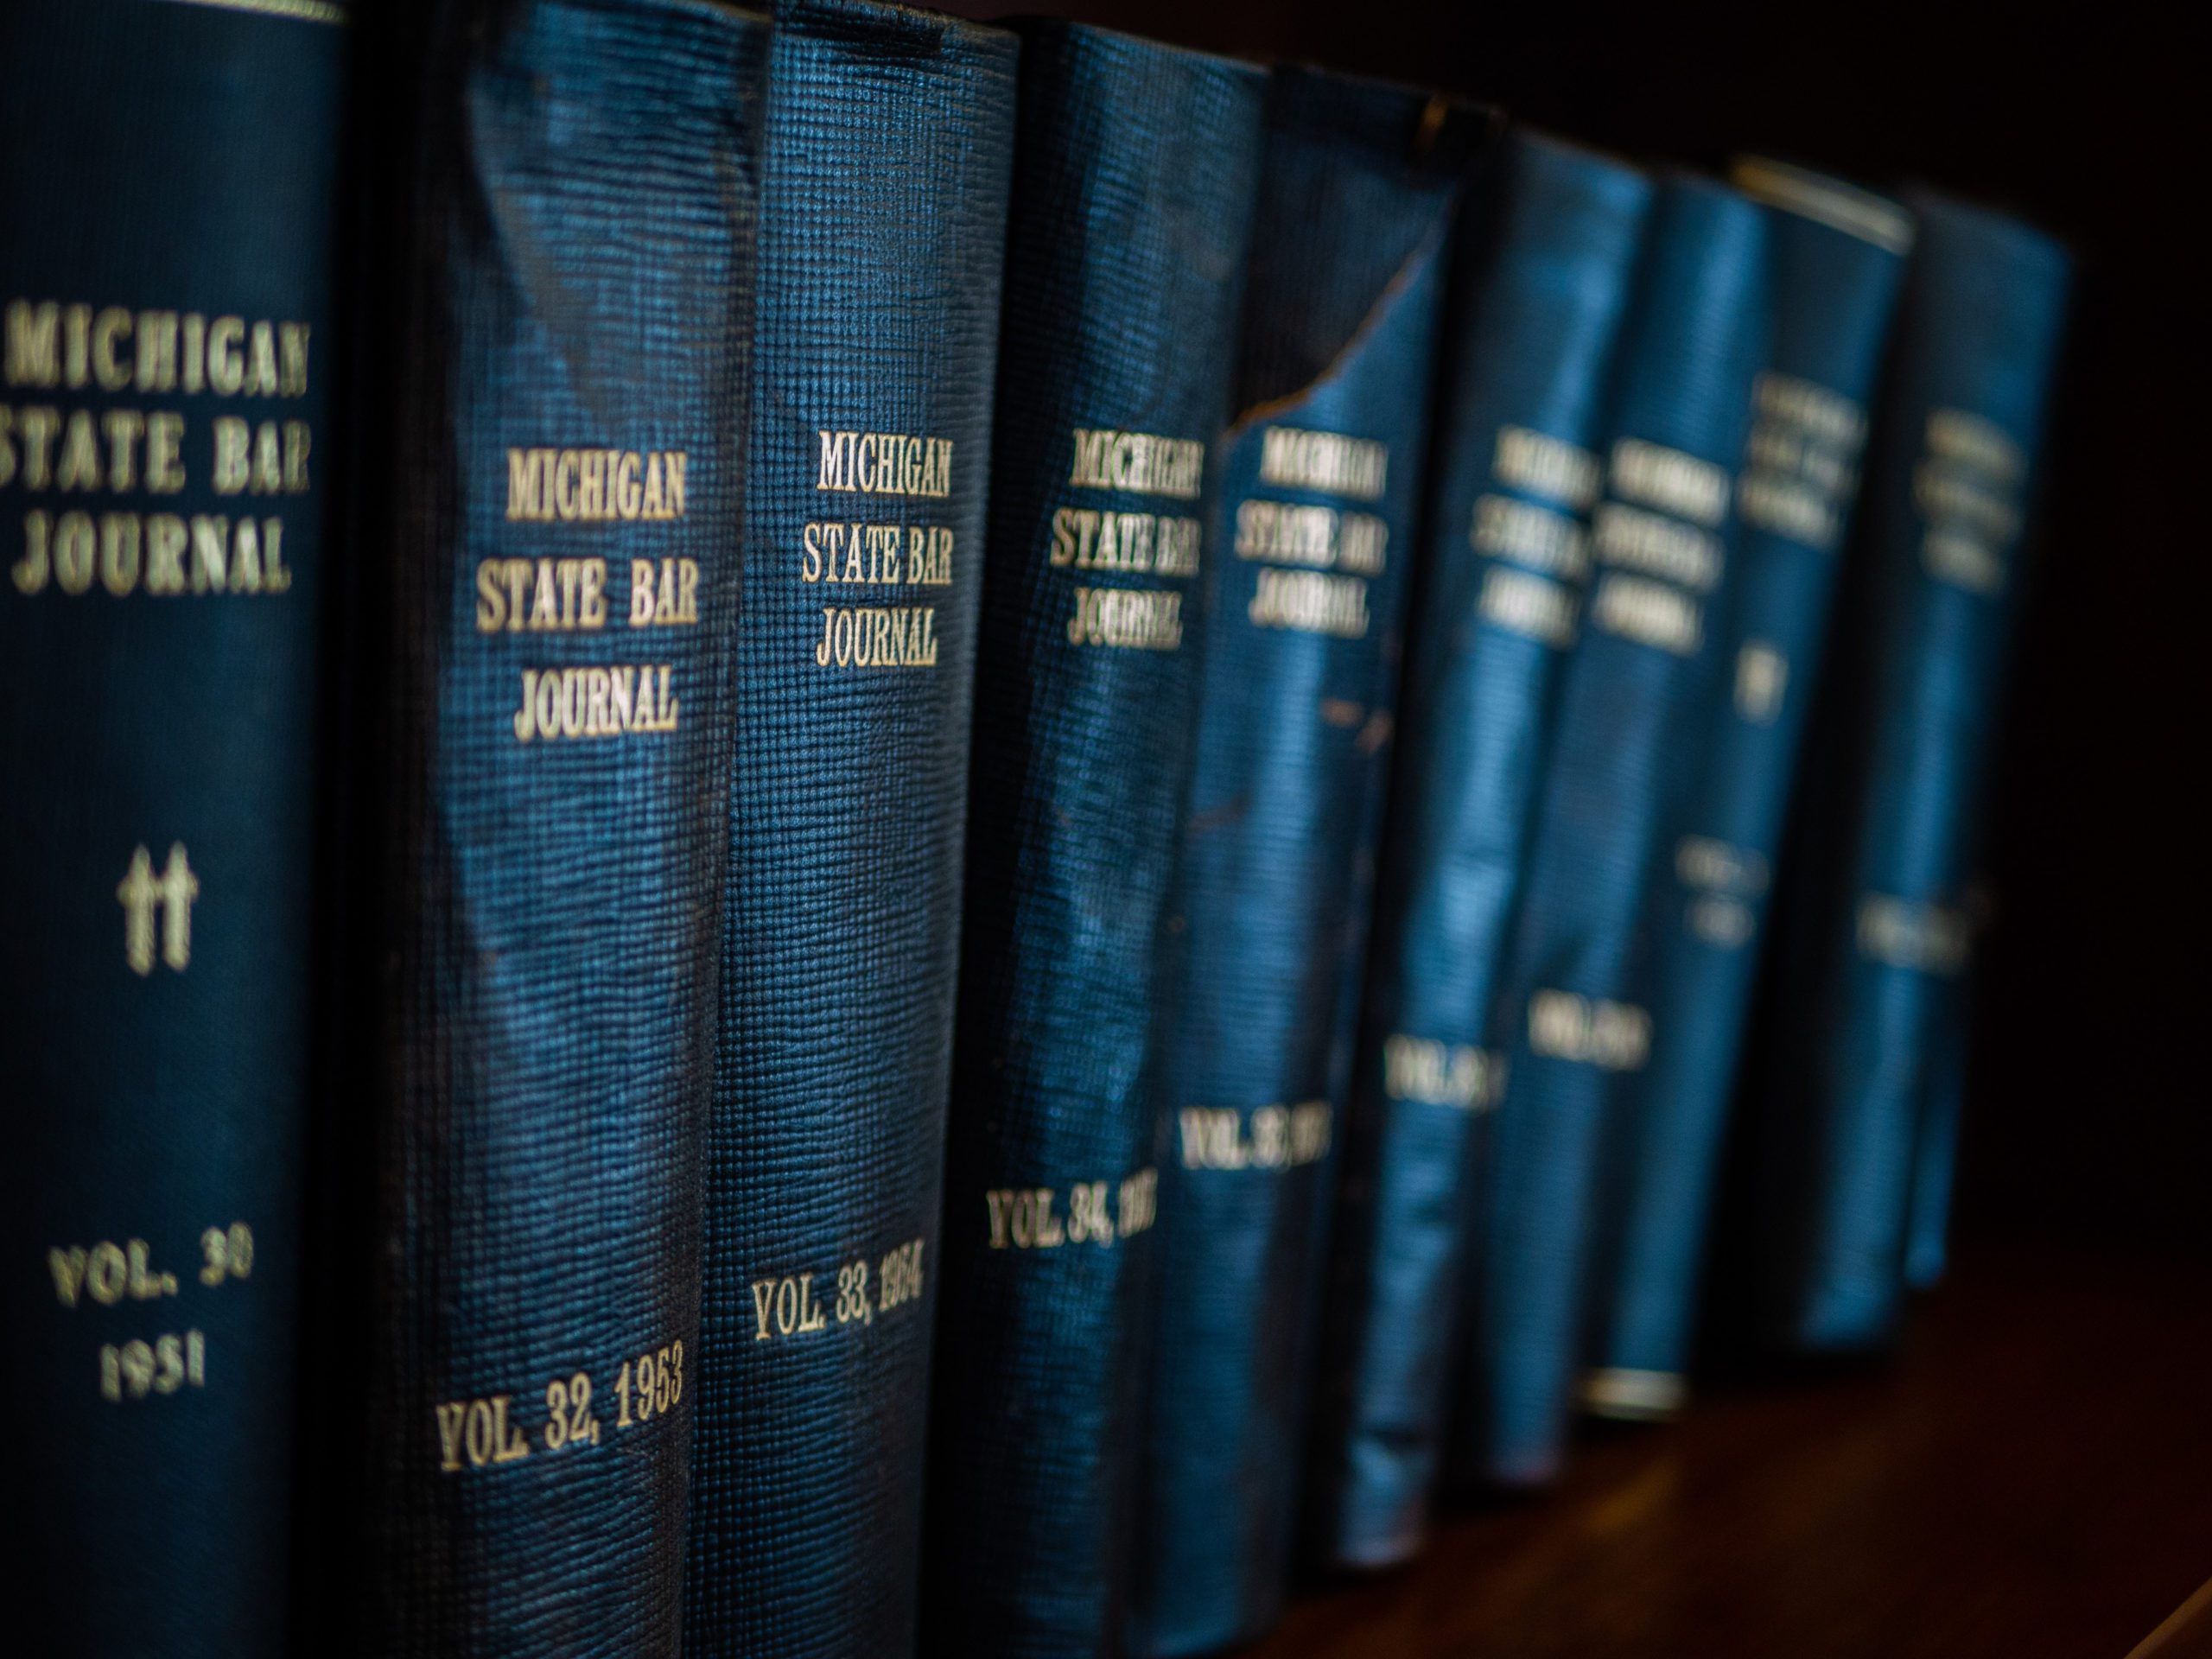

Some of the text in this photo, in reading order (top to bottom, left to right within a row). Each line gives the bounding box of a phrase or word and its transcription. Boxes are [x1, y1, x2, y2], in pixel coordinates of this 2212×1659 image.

[4, 299, 310, 398] MICHIGAN
[213, 416, 311, 495] BAR
[505, 447, 688, 523] MICHIGAN
[817, 430, 953, 498] MICHIGAN
[1069, 428, 1205, 500] MICHIGAN
[11, 508, 291, 596] JOURNAL
[802, 521, 954, 586] STATE BAR
[1049, 506, 1155, 571] STATE
[476, 556, 699, 633] STATE BAR
[1067, 587, 1183, 652] JOURNAL
[816, 607, 938, 667] JOURNAL
[514, 664, 679, 741] JOURNAL
[48, 1221, 253, 1307] VOL. 30
[752, 1238, 925, 1340] VOL. 33, 1954
[99, 1327, 205, 1403] 1951
[435, 1339, 683, 1471] VOL. 32, 1953
